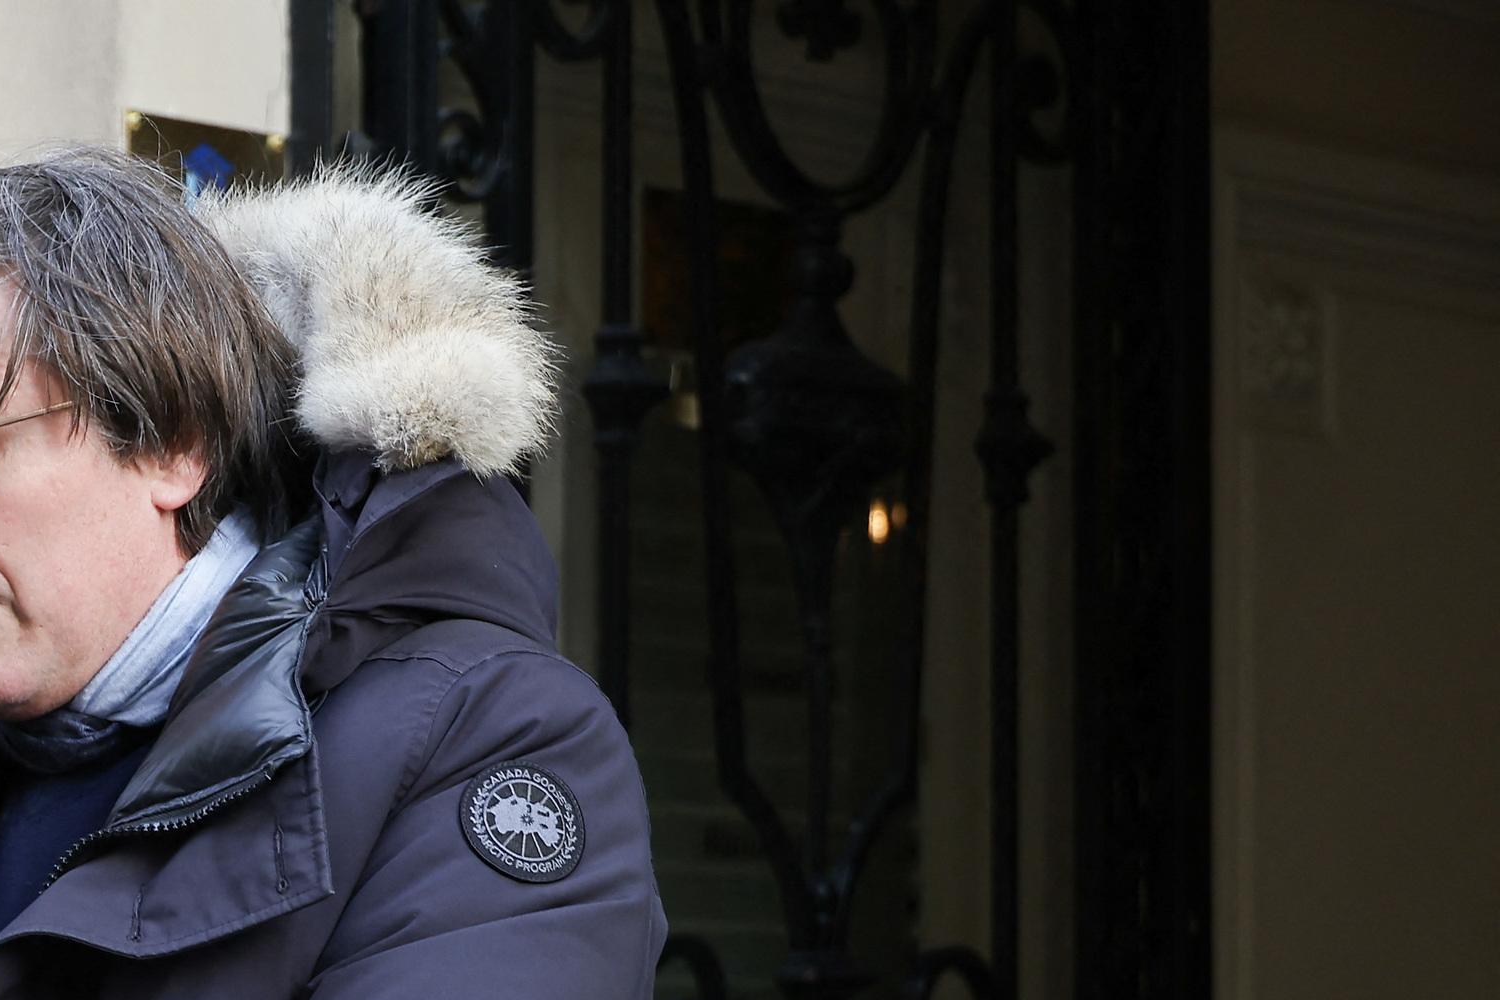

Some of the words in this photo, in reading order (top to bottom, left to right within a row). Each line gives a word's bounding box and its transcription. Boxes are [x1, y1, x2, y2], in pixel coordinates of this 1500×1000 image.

[483, 769, 531, 789] CANADA
[533, 773, 567, 806] GOOSE
[478, 834, 514, 866] ARCTIC
[516, 856, 566, 873] PROGRAM
